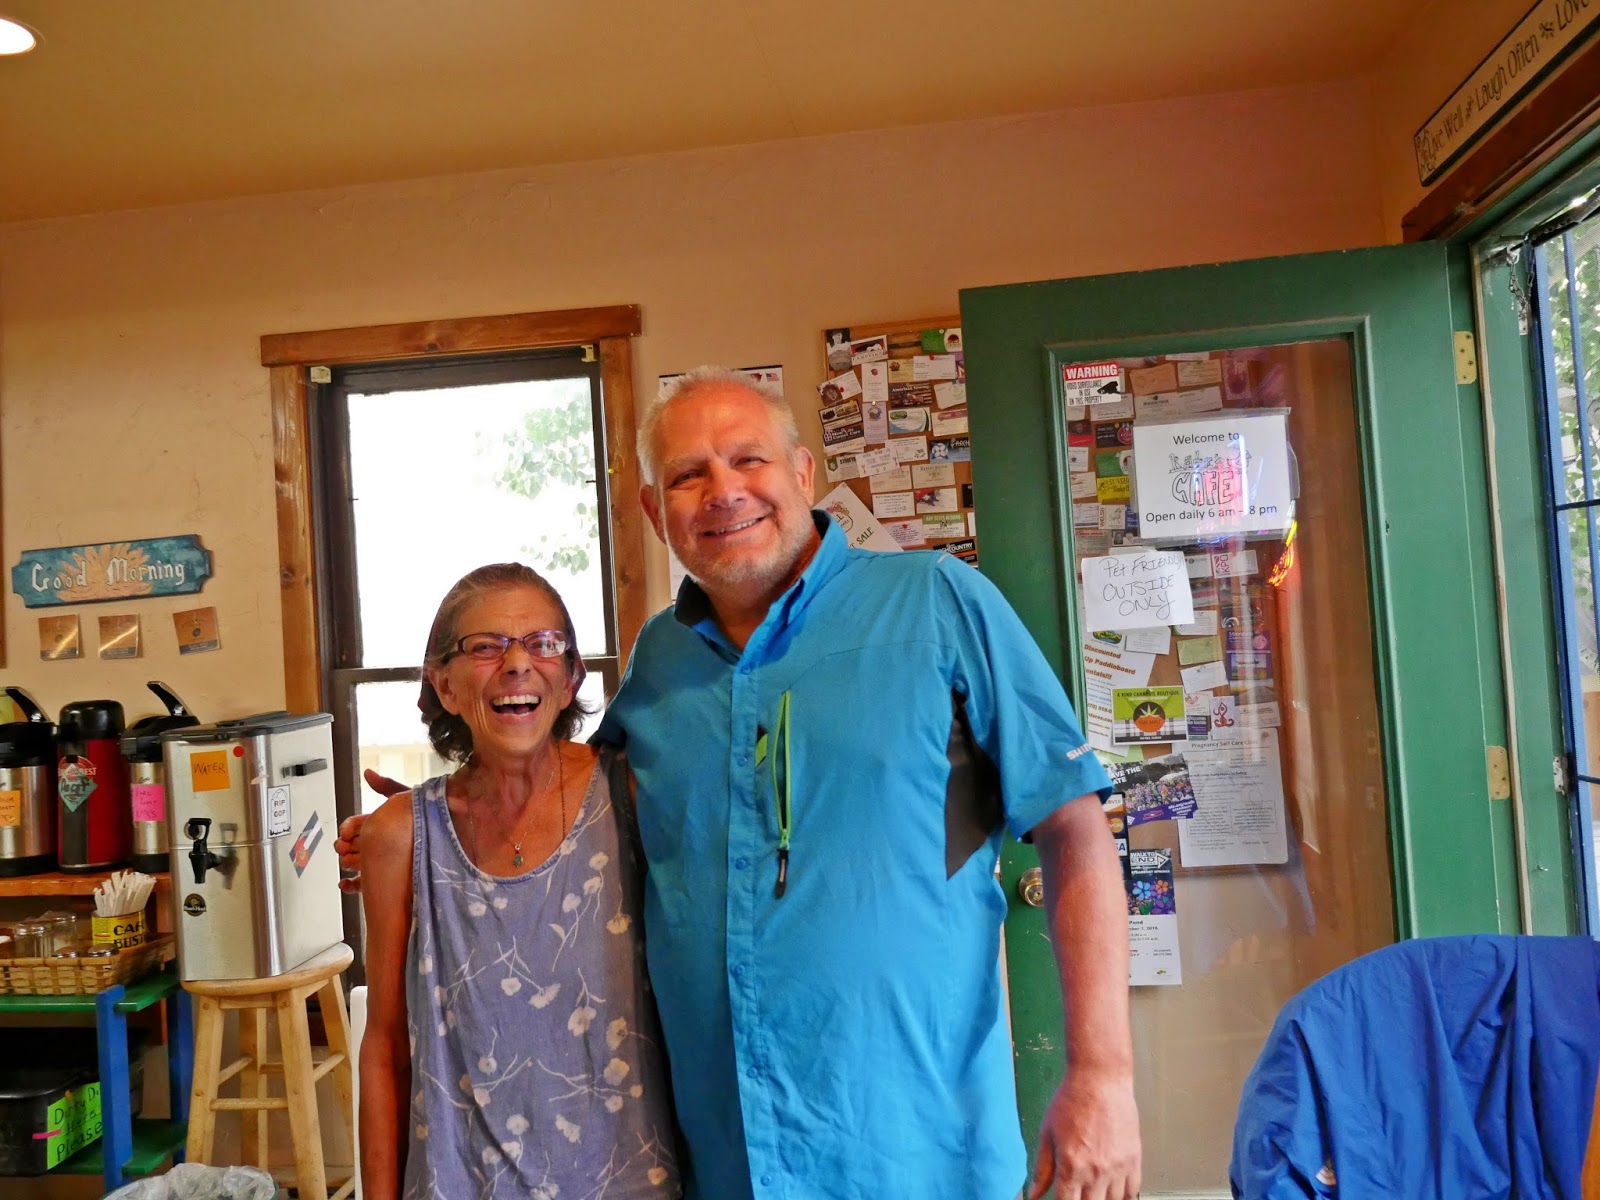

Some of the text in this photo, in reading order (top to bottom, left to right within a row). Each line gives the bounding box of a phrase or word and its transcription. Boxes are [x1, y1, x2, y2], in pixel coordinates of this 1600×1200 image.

[1443, 104, 1465, 138] Well
[1475, 64, 1508, 112] Laugh
[1507, 34, 1540, 79] Often
[1065, 364, 1118, 380] WARNING
[1066, 379, 1102, 390] VIDEO SURVEILLANCE
[1078, 389, 1084, 397] IN
[1069, 398, 1075, 406] ON
[1075, 397, 1084, 405] THIS
[1173, 432, 1240, 445] Welcome to
[1171, 470, 1235, 507] CAFE
[1145, 511, 1175, 523] Open
[1179, 509, 1206, 522] daily
[1208, 508, 1216, 518] 6
[1218, 508, 1236, 518] am
[1248, 505, 1256, 515] 8
[1259, 505, 1278, 517] pm
[856, 526, 875, 546] SALE
[31, 557, 186, 592] Good Morning
[1102, 574, 1175, 602] OUTSIDE
[1118, 590, 1176, 620] ONLY
[1084, 644, 1121, 659] Discounted
[1084, 655, 1136, 675] Up Paddleboard
[1085, 668, 1113, 680] entals!!!
[193, 762, 226, 776] WATER
[1126, 766, 1141, 775] THE
[274, 799, 286, 808] RIP
[113, 920, 145, 936] CAF
[113, 935, 145, 949] BUST
